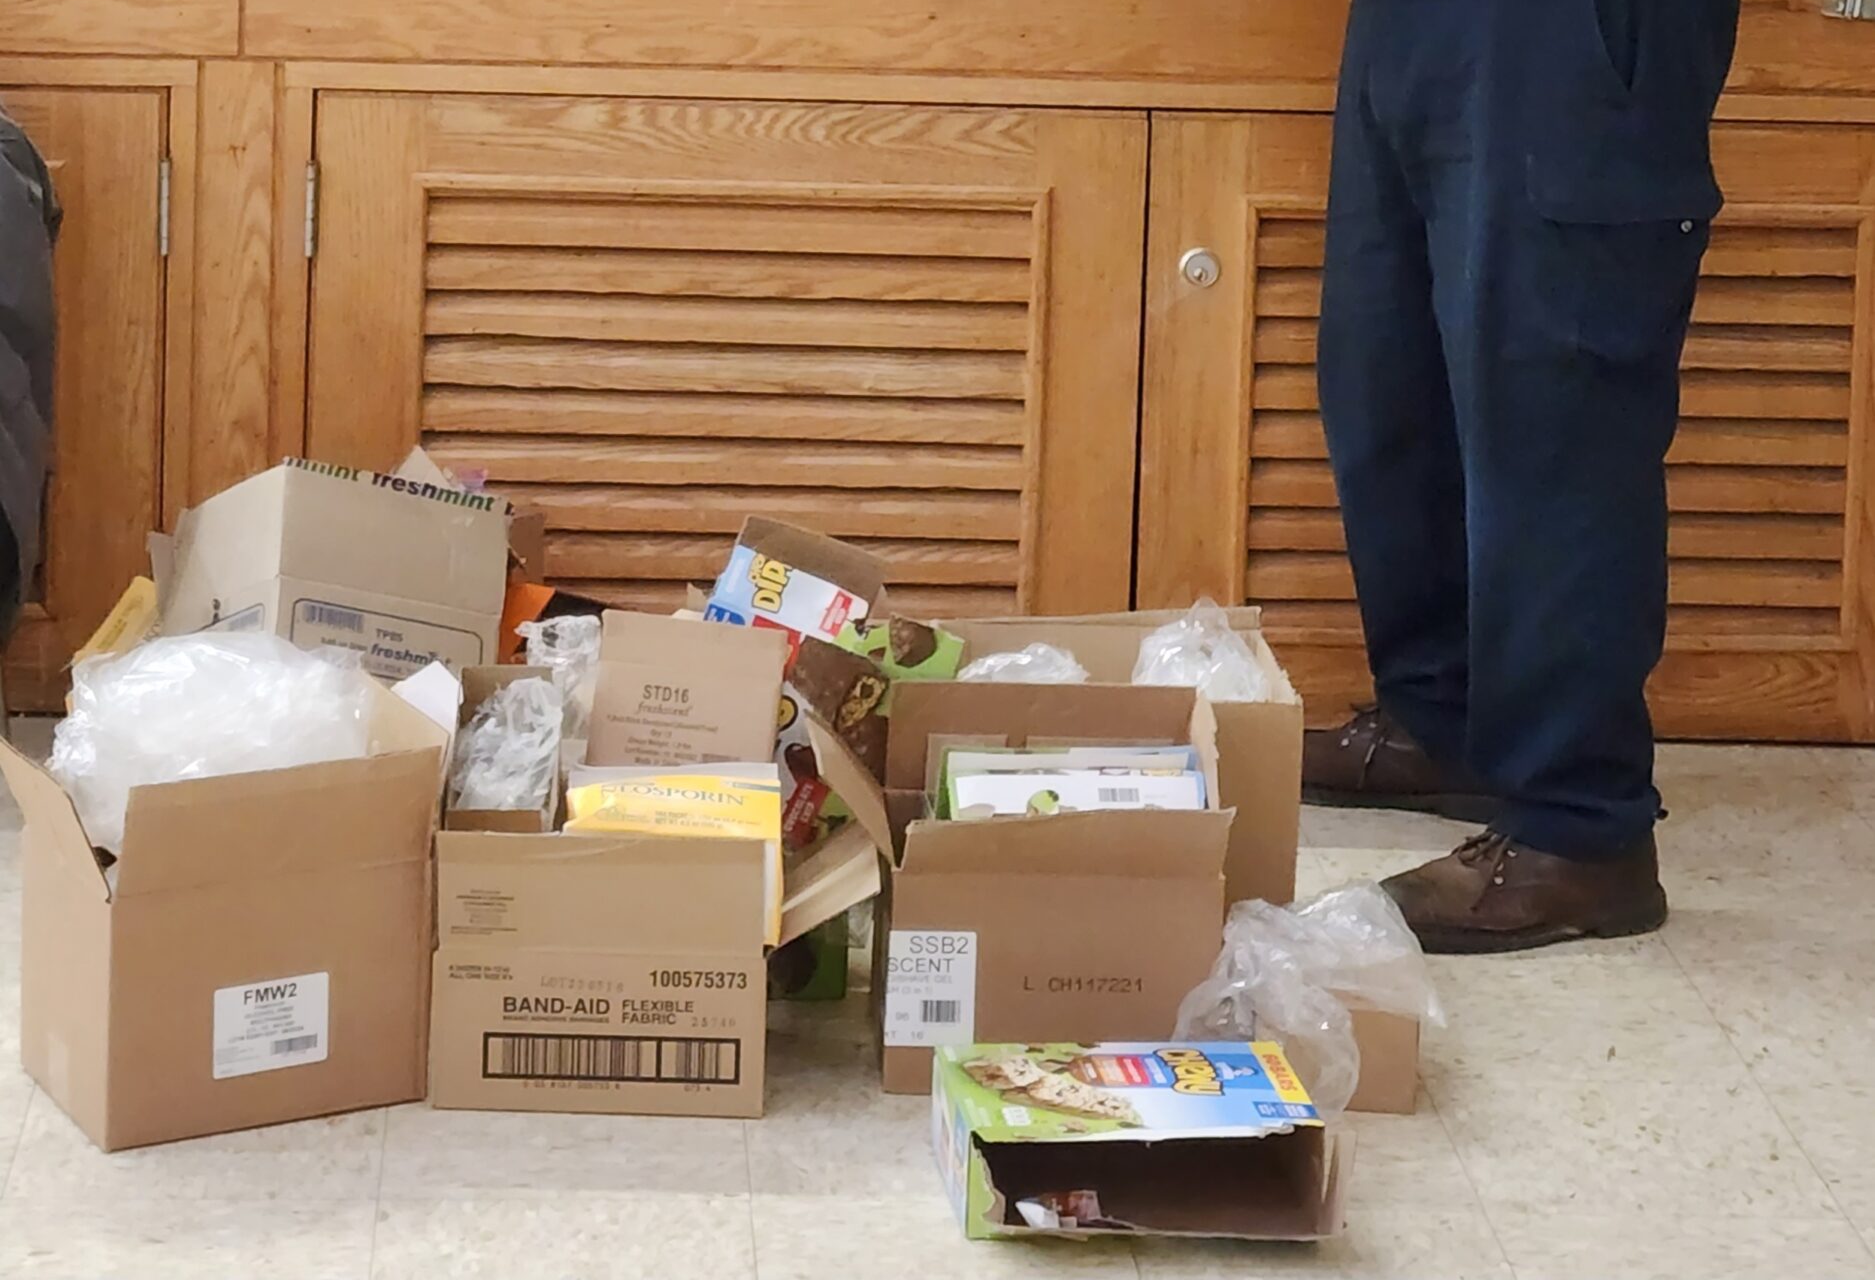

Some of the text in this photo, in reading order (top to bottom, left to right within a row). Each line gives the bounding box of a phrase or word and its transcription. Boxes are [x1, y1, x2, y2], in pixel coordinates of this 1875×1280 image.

[752, 560, 791, 614] DIP
[371, 643, 451, 667] freshmi
[643, 684, 690, 704] STD16
[909, 935, 970, 955] SSB2
[888, 957, 955, 974] SCENT
[649, 970, 748, 990] 100575373
[1048, 976, 1144, 993] CH117221
[244, 982, 297, 1006] FMW2
[503, 997, 611, 1016] BAND-AID
[622, 1000, 695, 1014] FLEXIBLE
[621, 1012, 678, 1026] FABRIC
